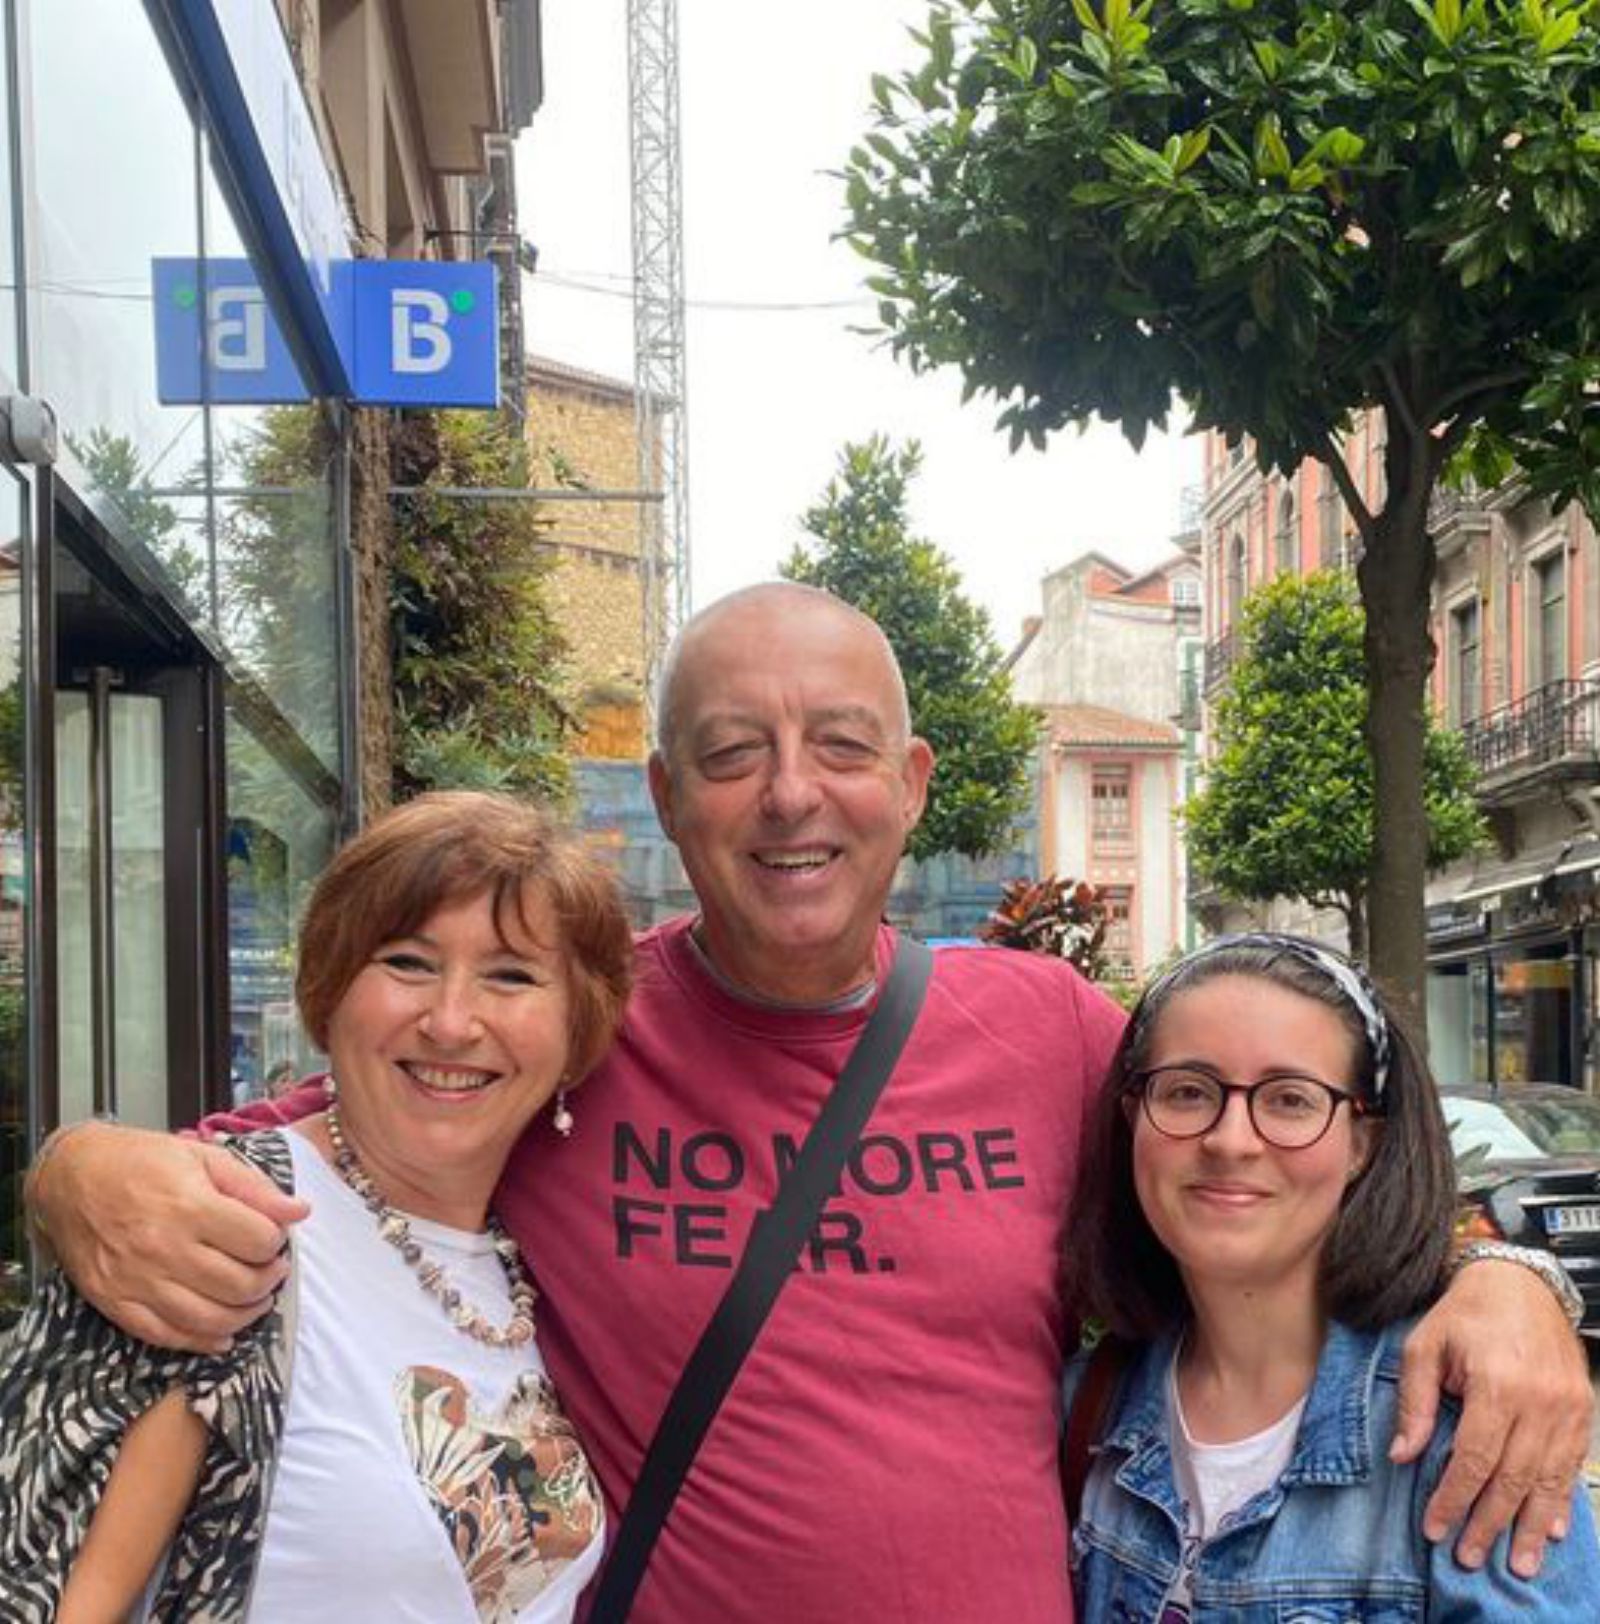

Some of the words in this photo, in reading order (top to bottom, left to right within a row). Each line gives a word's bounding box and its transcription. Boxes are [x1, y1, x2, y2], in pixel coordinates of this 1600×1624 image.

[391, 287, 452, 373] B
[612, 1121, 745, 1192] NO
[612, 1195, 896, 1275] FER.
